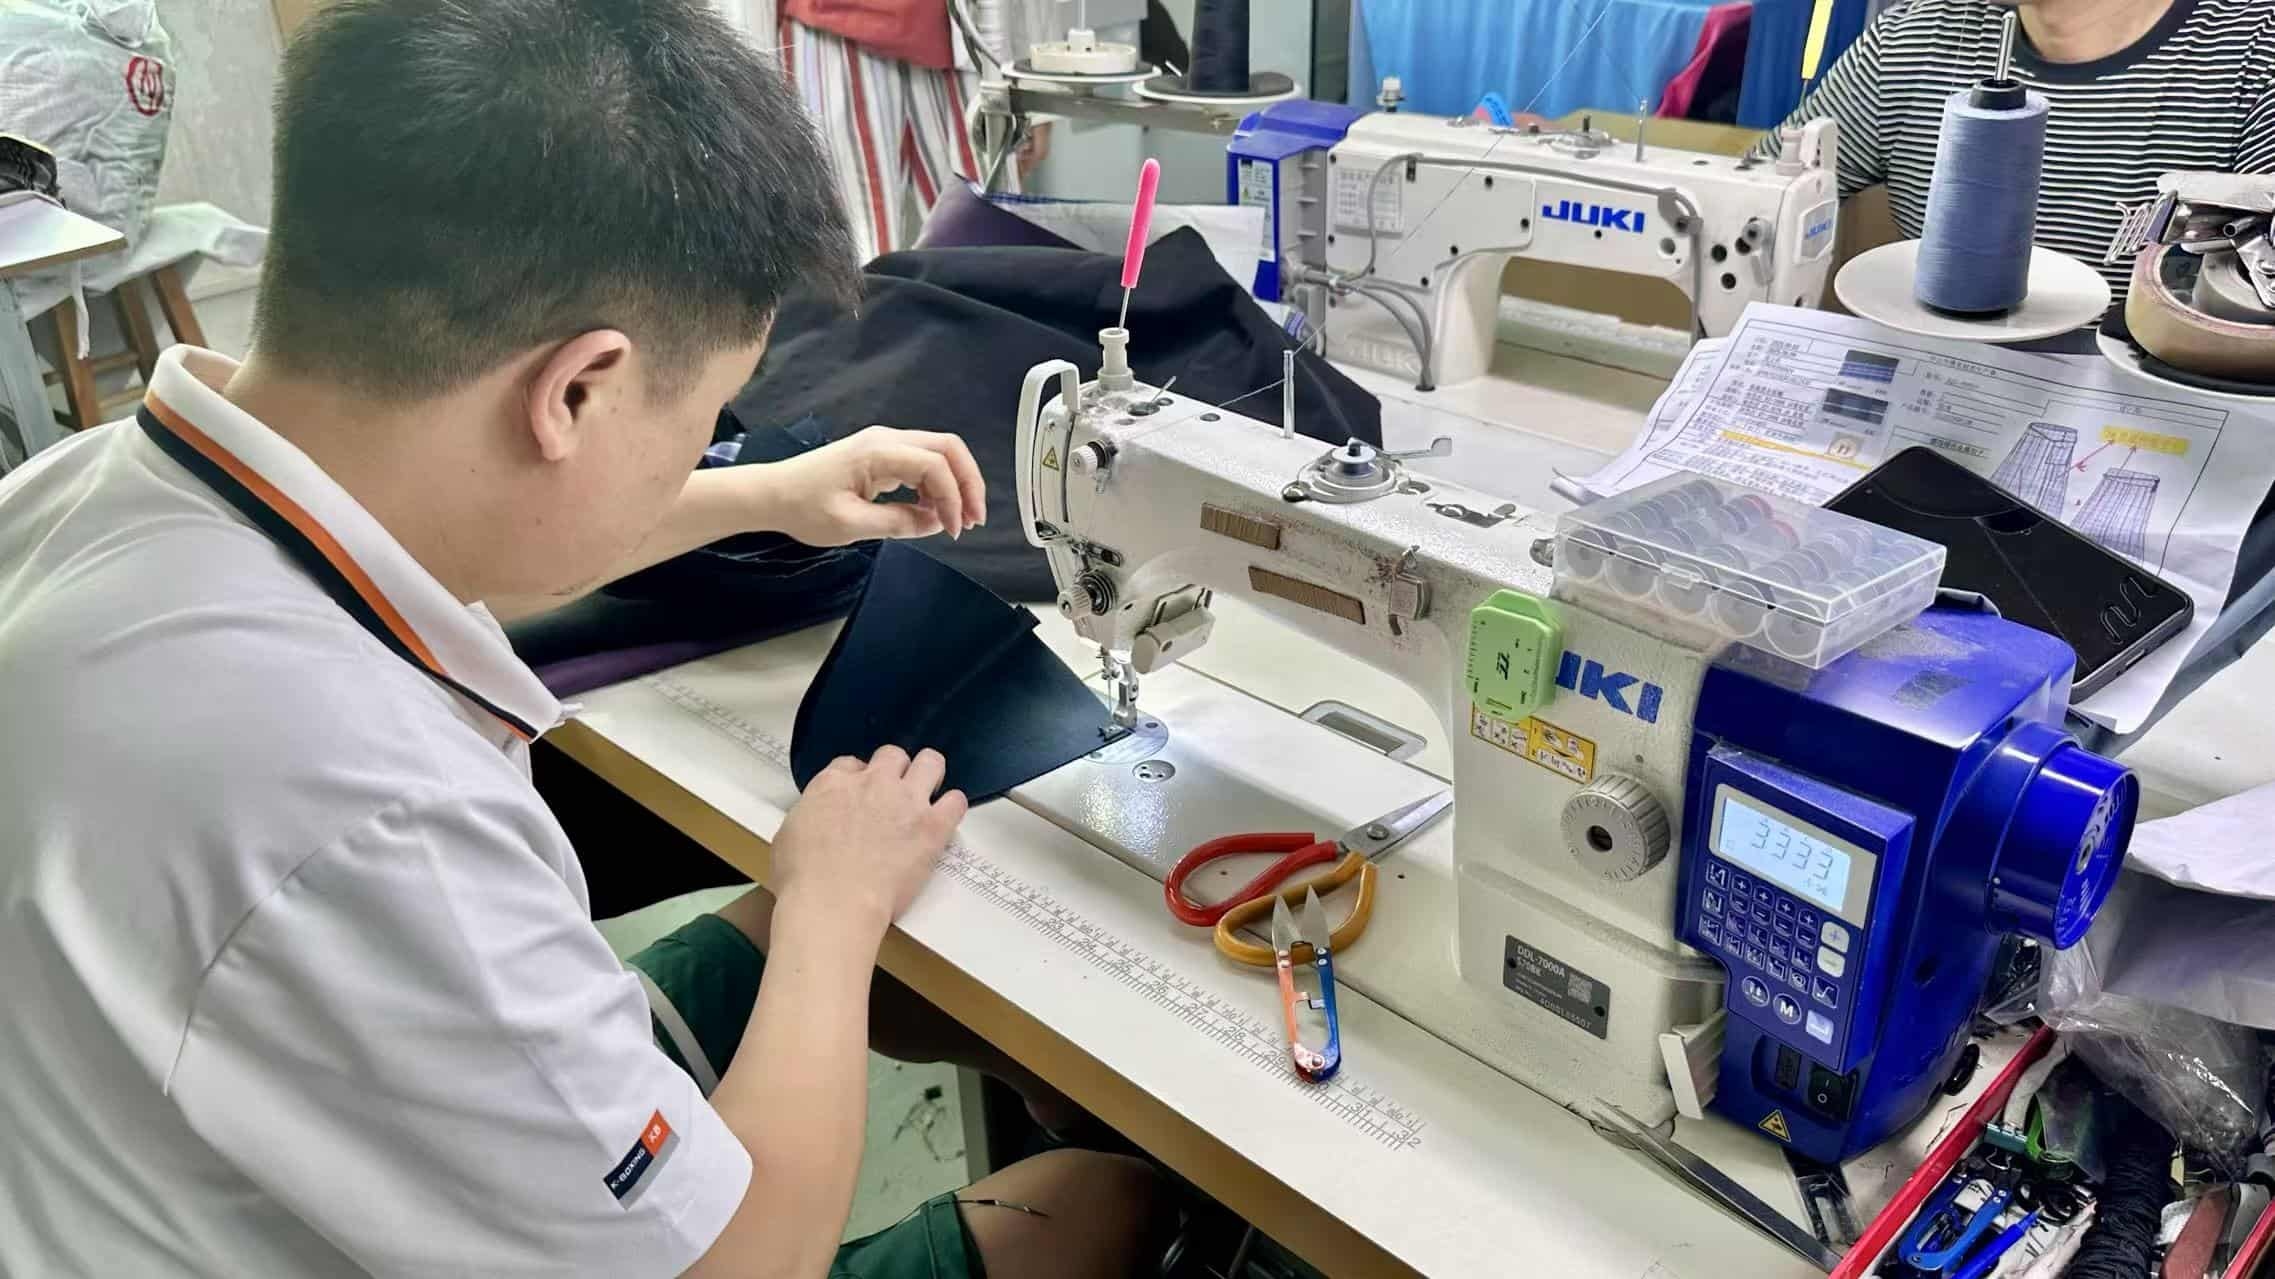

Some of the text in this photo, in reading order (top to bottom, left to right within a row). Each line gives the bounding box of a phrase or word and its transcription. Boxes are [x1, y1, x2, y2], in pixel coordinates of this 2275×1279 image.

[1542, 200, 1645, 234] JUKI
[1751, 820, 1834, 881] 3333
[1517, 945, 1565, 977] DDL-7000A
[1779, 1001, 1794, 1018] M
[1186, 1003, 1210, 1019] 27
[1223, 1026, 1247, 1042] 28
[1264, 1050, 1288, 1068] 29
[1350, 1102, 1373, 1118] 31
[1396, 1130, 1422, 1150] 32
[648, 1123, 662, 1144] KB
[610, 1148, 646, 1189] K-BOXING
